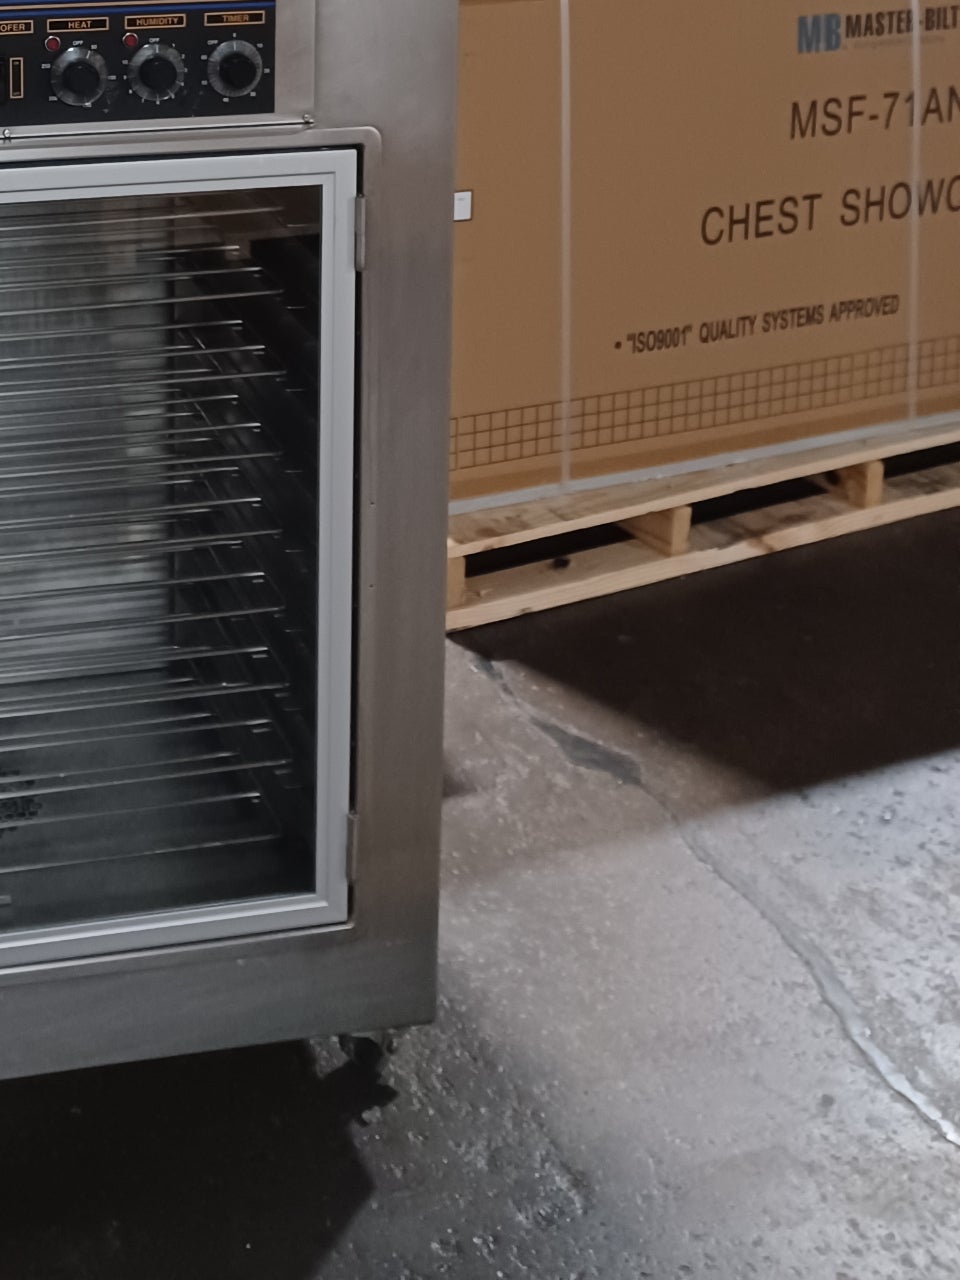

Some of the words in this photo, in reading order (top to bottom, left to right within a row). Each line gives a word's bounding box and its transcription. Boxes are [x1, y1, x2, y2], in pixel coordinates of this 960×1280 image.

[68, 20, 93, 29] HEAT
[136, 17, 179, 26] HUMIDITY
[222, 14, 249, 22] TIMER
[798, 13, 842, 54] MB
[701, 193, 823, 246] CHEST
[699, 315, 757, 344] QUALITY
[762, 304, 824, 333] SYSTEMS
[829, 294, 900, 321] APPROVED
